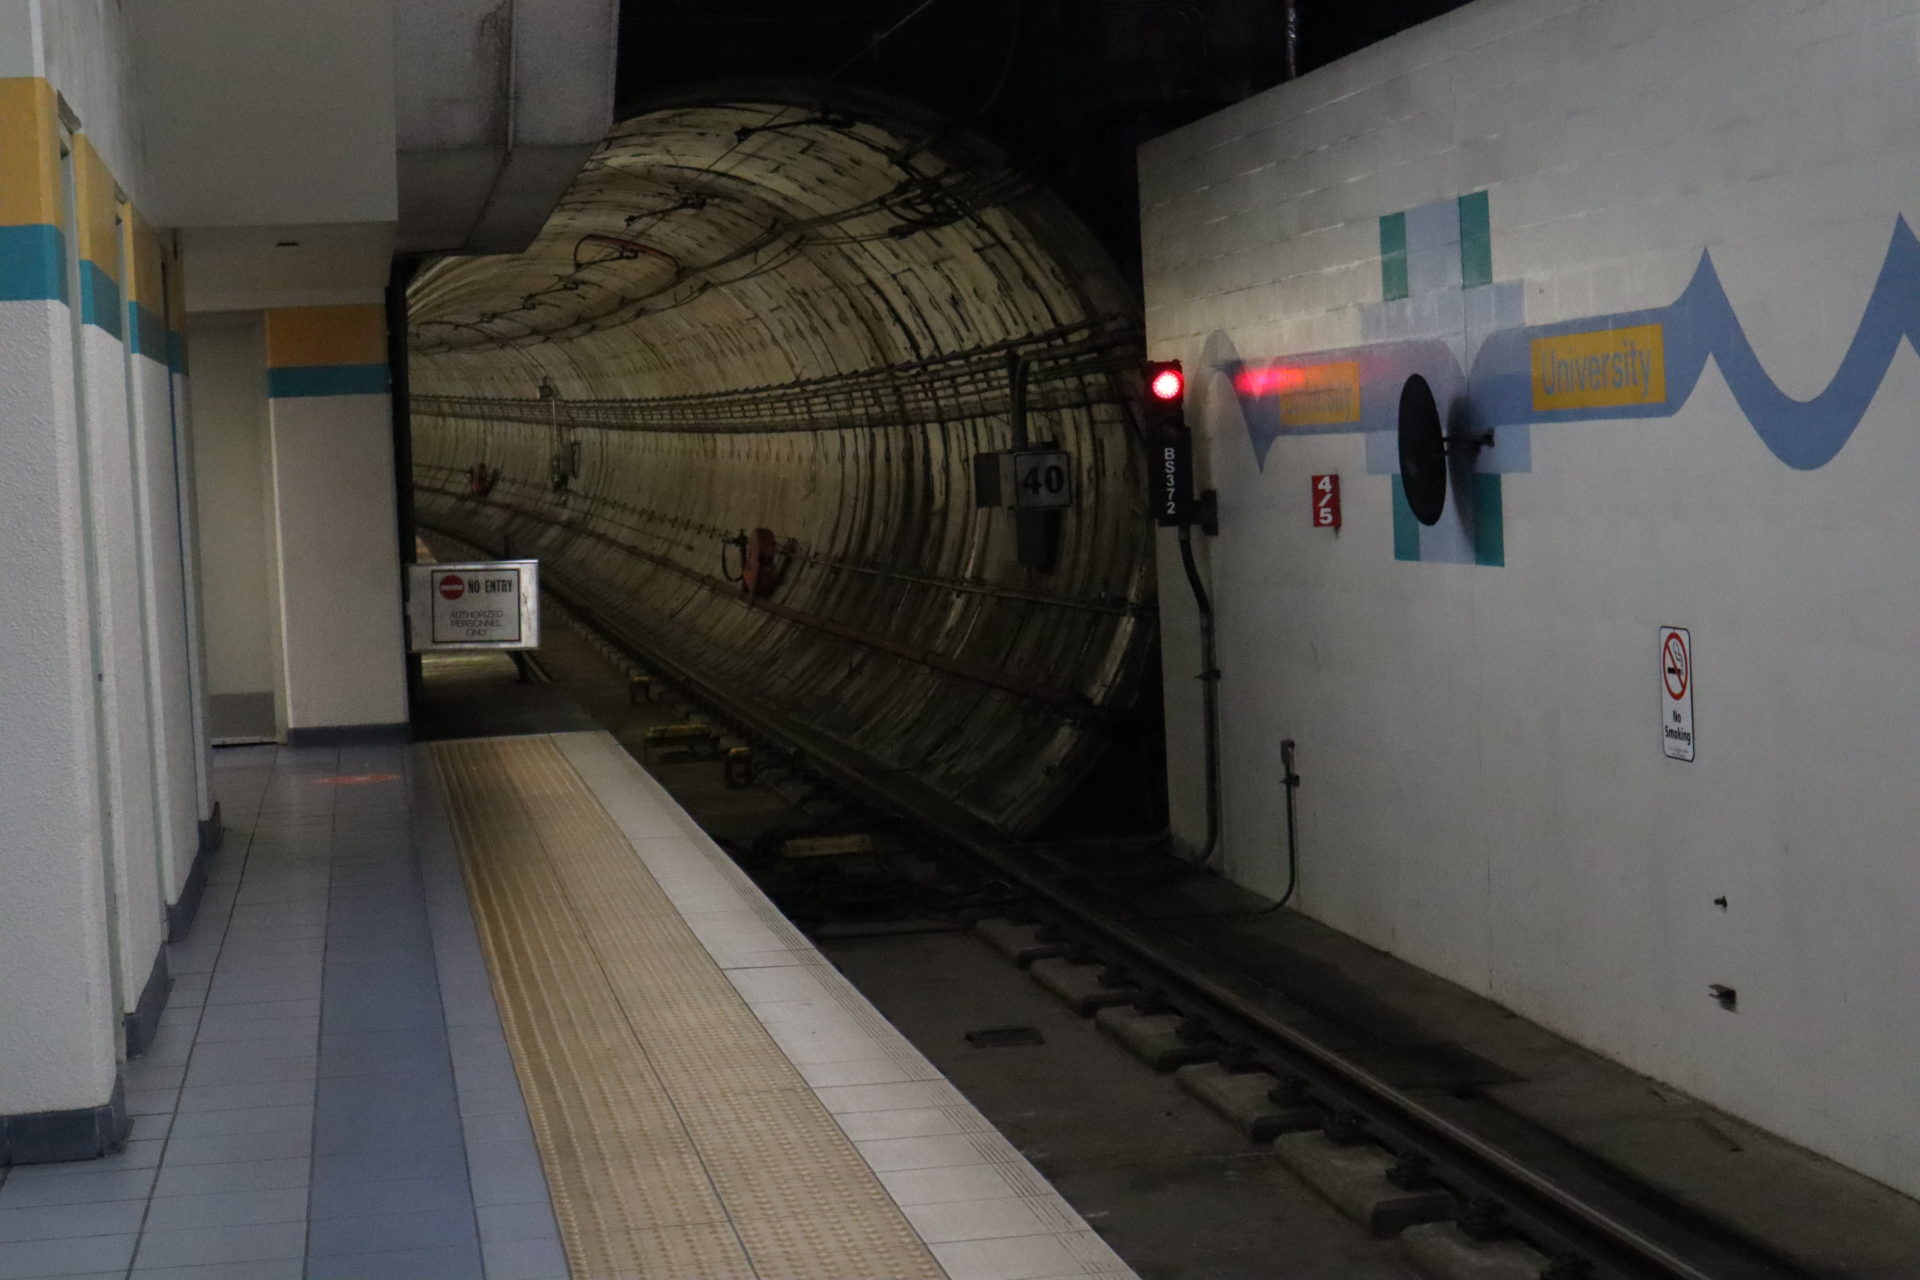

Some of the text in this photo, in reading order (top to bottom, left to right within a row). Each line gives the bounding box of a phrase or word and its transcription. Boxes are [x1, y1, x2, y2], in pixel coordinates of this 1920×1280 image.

[1540, 340, 1652, 399] University
[1022, 465, 1065, 495] 40
[1164, 447, 1176, 514] BS372
[467, 579, 513, 594] NO ENTRY
[449, 609, 504, 619] AUTHORIZED
[466, 628, 488, 637] ONLY
[1672, 709, 1682, 723] No
[1664, 725, 1691, 746] Smoking
